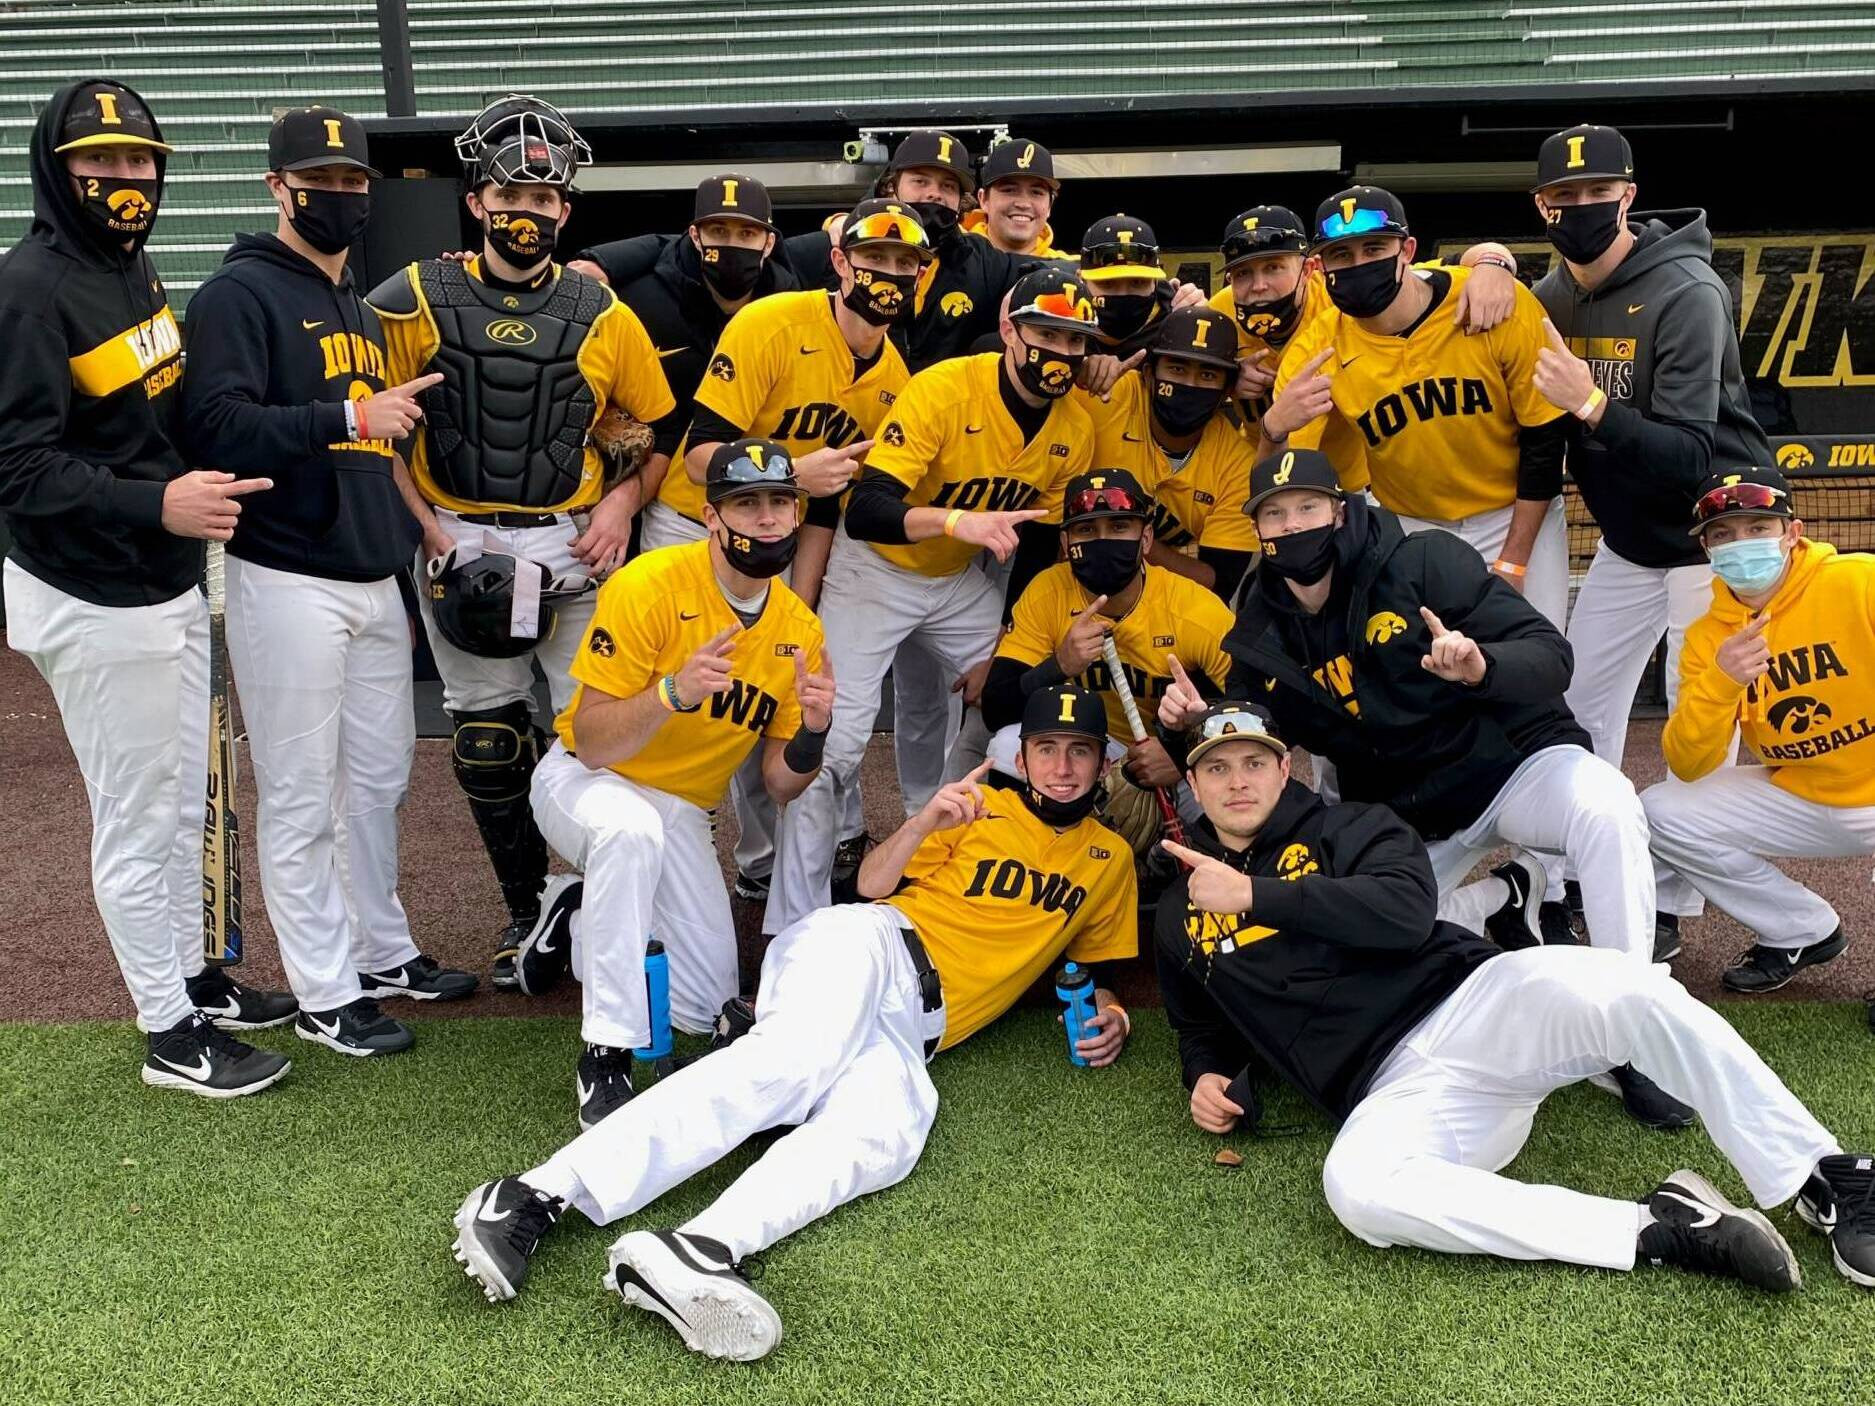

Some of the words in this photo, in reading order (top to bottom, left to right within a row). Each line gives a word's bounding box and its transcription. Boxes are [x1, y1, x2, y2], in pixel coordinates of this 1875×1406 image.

[95, 93, 121, 124] I
[323, 119, 345, 148] I
[937, 136, 953, 163] I
[1567, 136, 1585, 169] I
[87, 180, 99, 197] 2
[297, 191, 307, 207] 6
[722, 180, 738, 207] I
[492, 213, 509, 229] 32
[1548, 209, 1562, 224] 27
[704, 248, 719, 262] 29
[854, 270, 872, 287] 38
[1191, 318, 1212, 348] I
[1029, 350, 1039, 362] 9
[1158, 383, 1173, 397] 20
[1356, 376, 1494, 448] IOWA
[1070, 545, 1082, 559] 31
[1058, 693, 1077, 722] I
[1760, 718, 1875, 761] BASEBALL
[963, 858, 1087, 926] IOWA
